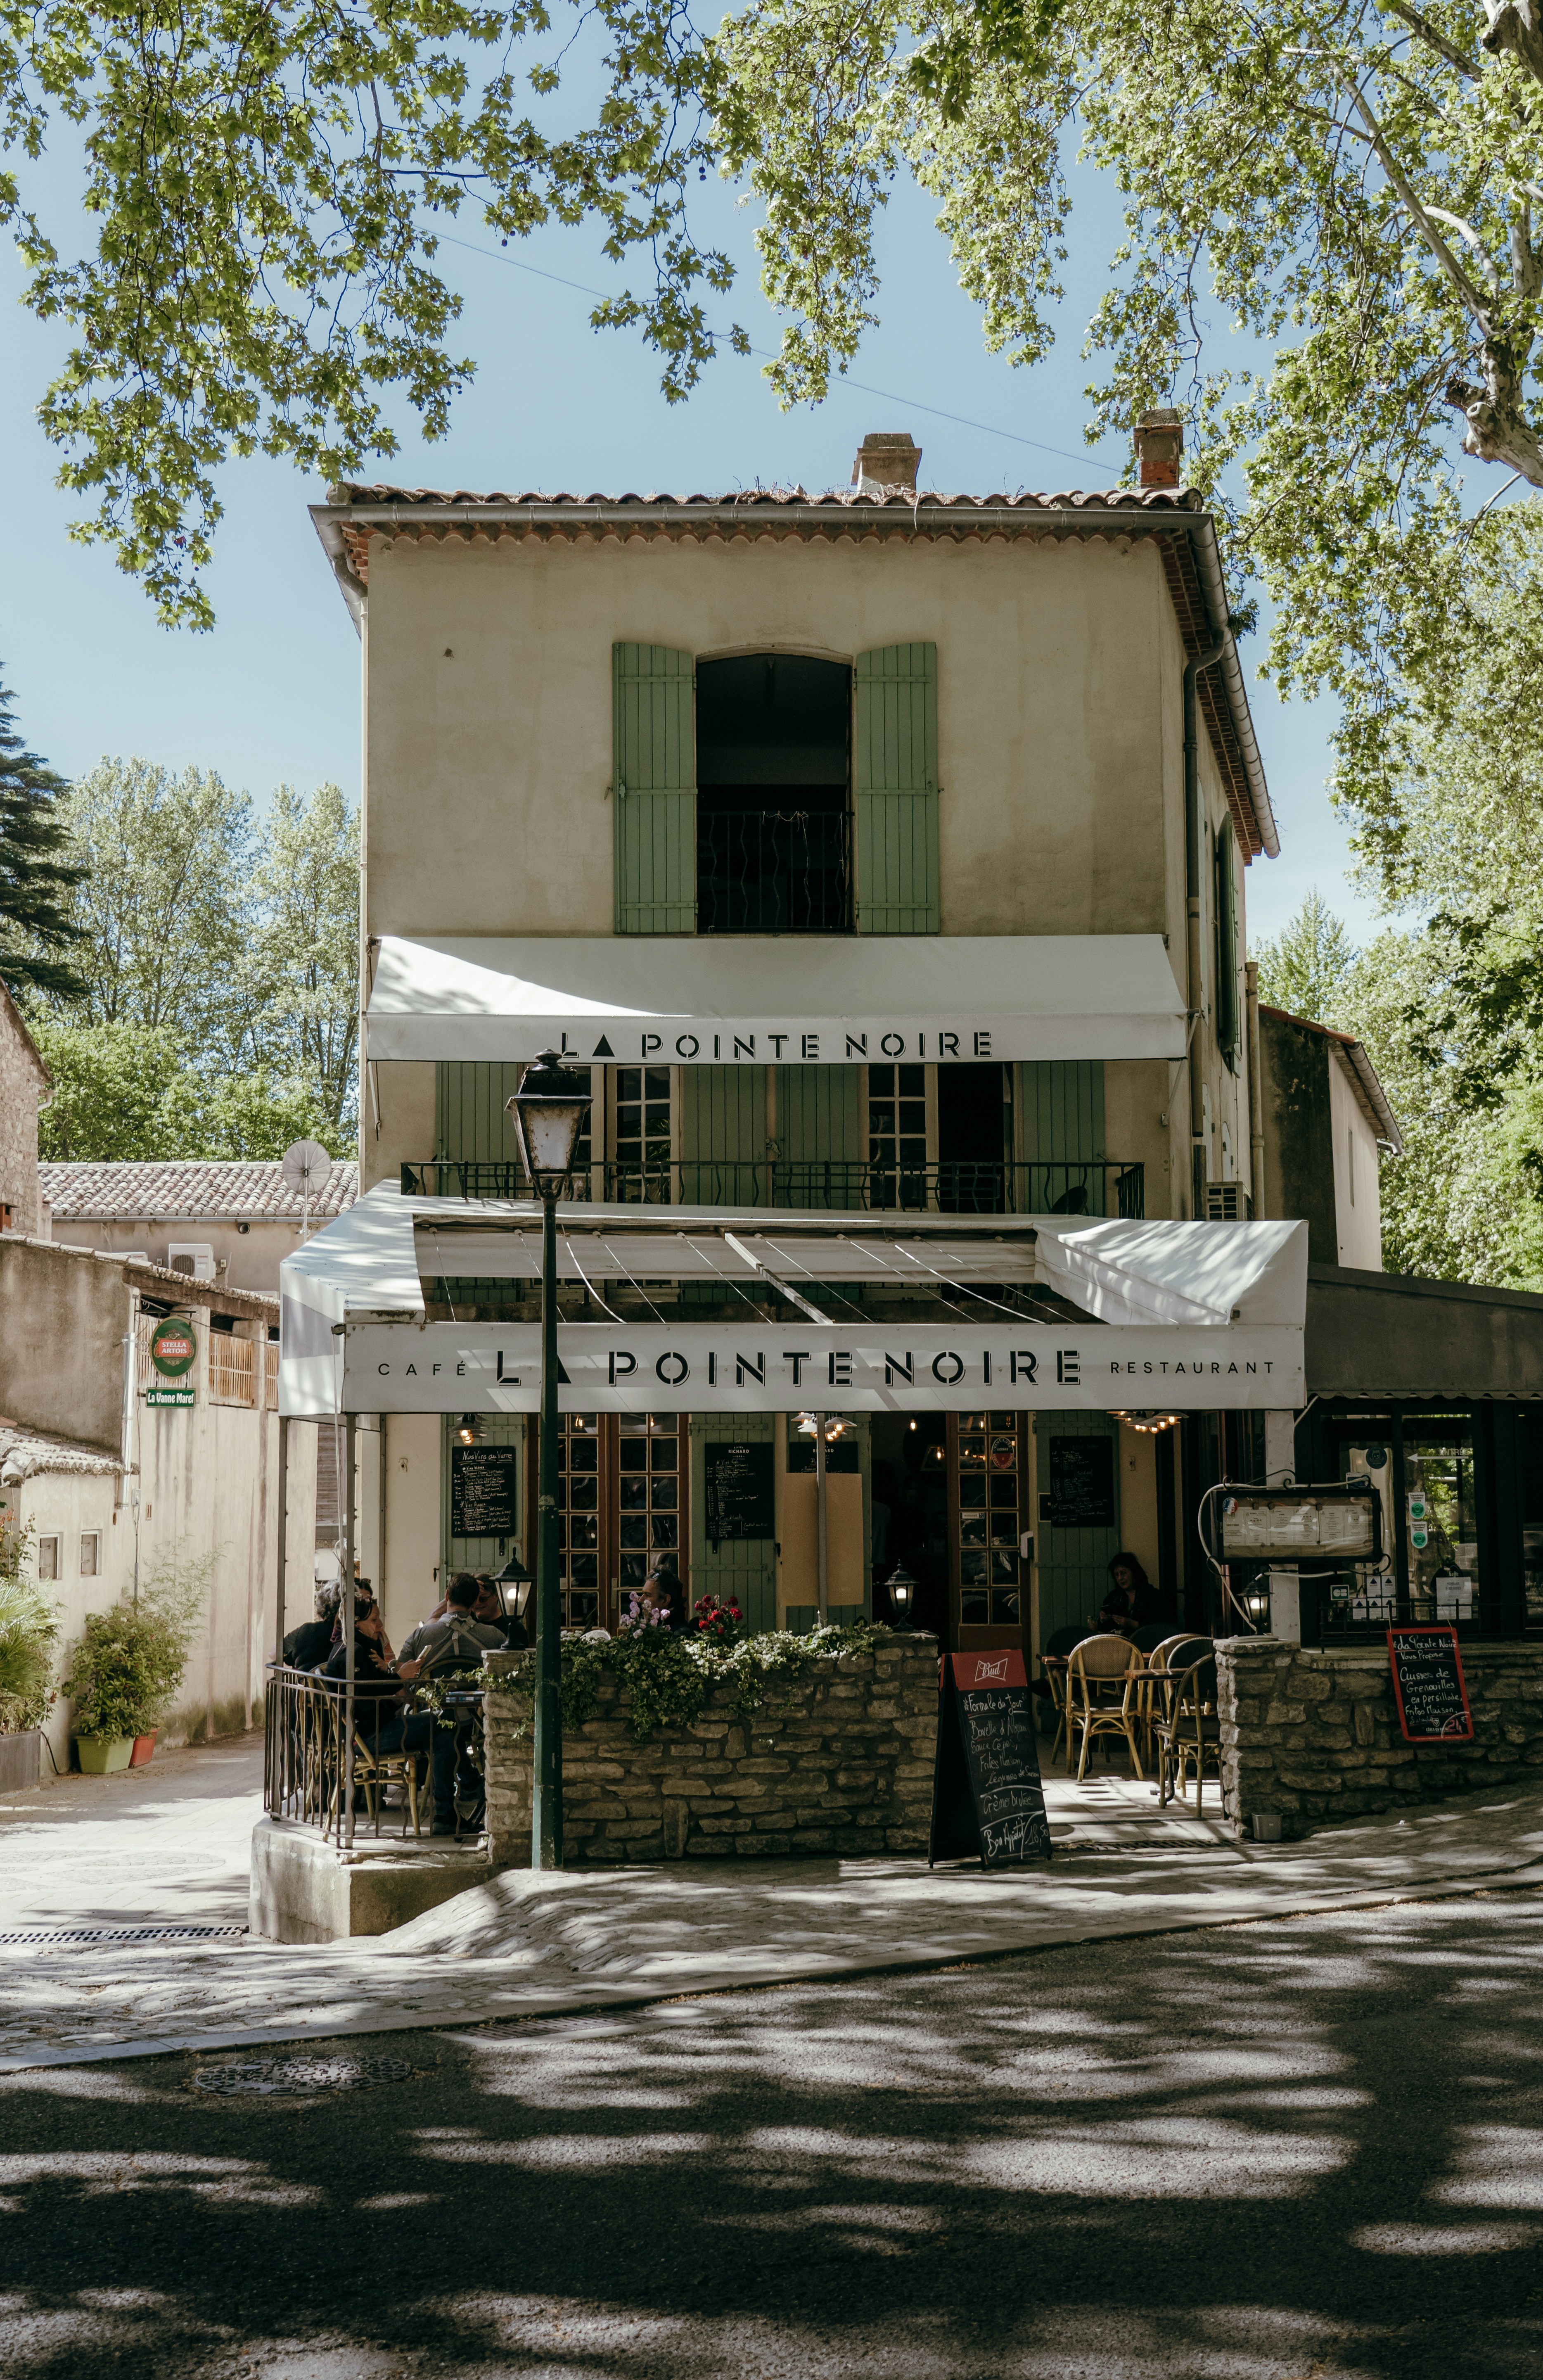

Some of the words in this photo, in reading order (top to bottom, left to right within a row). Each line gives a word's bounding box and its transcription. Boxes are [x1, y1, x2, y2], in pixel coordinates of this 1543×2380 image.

[562, 1032, 615, 1058] LA
[642, 1034, 820, 1060] POINTE
[846, 1032, 992, 1058] NOIRE
[378, 1361, 466, 1376] CAFÉ
[609, 1351, 852, 1387] POINTE
[885, 1350, 1081, 1387] NOIRE
[1111, 1362, 1273, 1374] RESTAURANT
[148, 1392, 155, 1403] La
[156, 1392, 175, 1404] Vanne
[177, 1393, 194, 1404] Marel
[462, 1450, 474, 1460] Nos
[474, 1450, 487, 1460] Vins
[497, 1449, 512, 1459] Verre
[1408, 1635, 1437, 1649] Pointe
[1439, 1637, 1458, 1648] Noire
[1400, 1652, 1417, 1660] Vous
[1417, 1649, 1444, 1661] Propose
[979, 1662, 1000, 1677] Bud
[1436, 1668, 1451, 1678] de
[1406, 1679, 1455, 1693] Grenouilles
[968, 1693, 996, 1712] Formule
[998, 1696, 1006, 1710] du
[1405, 1704, 1425, 1715] Frites
[971, 1740, 991, 1754] Sauce
[980, 1751, 999, 1772] Frites
[1018, 1769, 1025, 1777] de
[984, 1829, 1003, 1857] Bon
